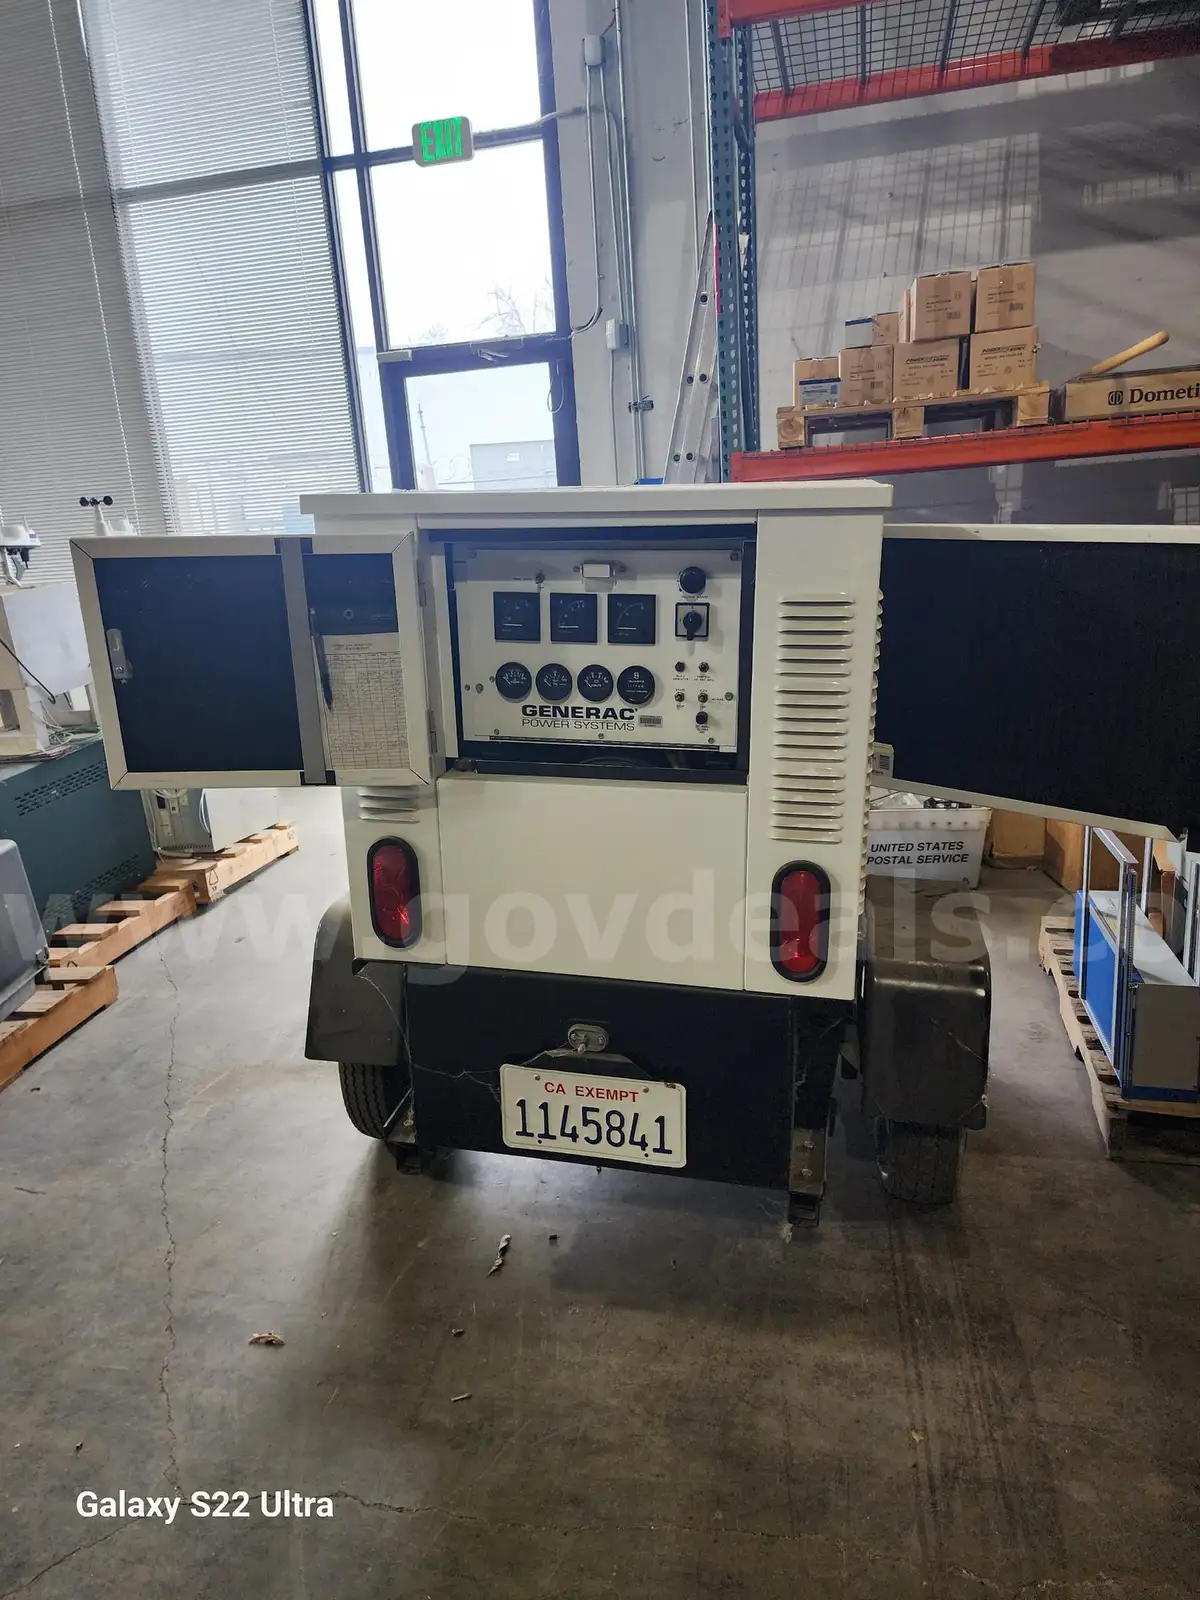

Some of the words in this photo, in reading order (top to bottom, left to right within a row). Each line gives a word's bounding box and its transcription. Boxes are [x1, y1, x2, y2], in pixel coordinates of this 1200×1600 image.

[420, 116, 463, 162] EXIT
[521, 704, 635, 721] GENERAC
[521, 718, 570, 729] POWER
[573, 720, 635, 731] SYSTEMS
[870, 842, 914, 852] UNITED
[916, 841, 964, 852] STATES
[866, 855, 913, 865] POSTAL
[916, 853, 969, 864] SERVICE
[544, 1081, 566, 1095] CA
[575, 1085, 640, 1103] EXEMPT
[515, 1098, 673, 1155] 1145841
